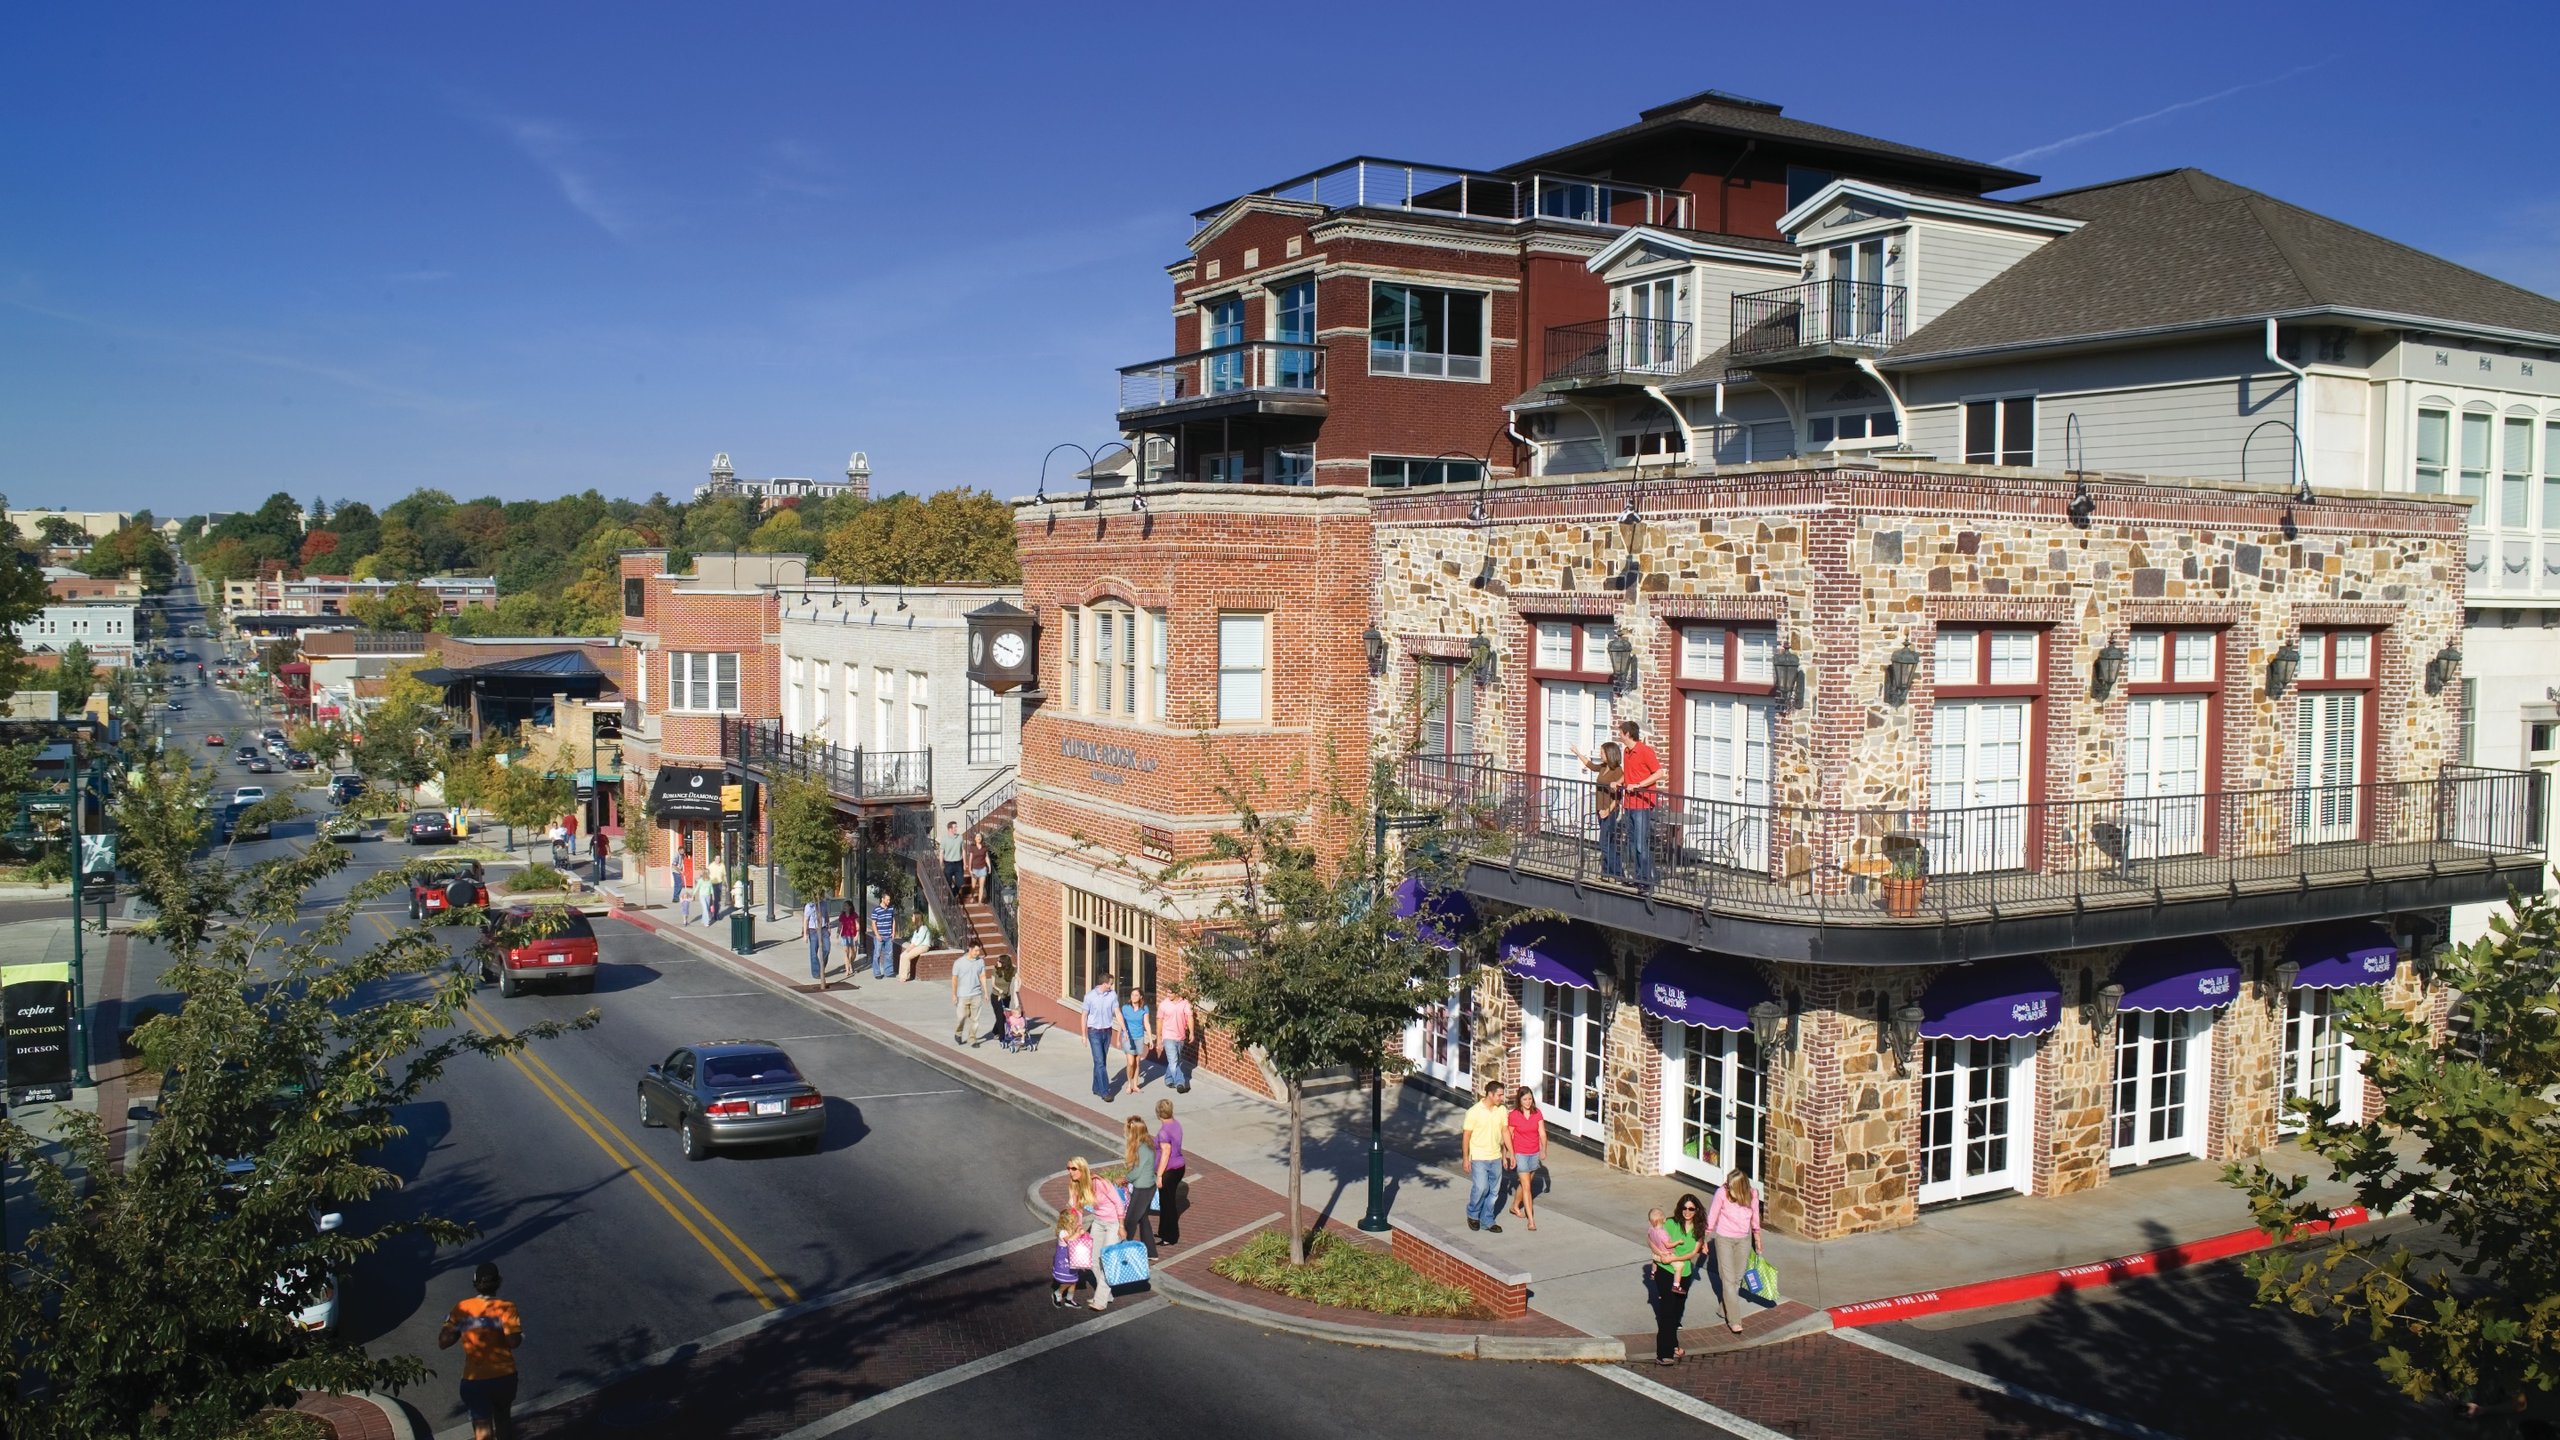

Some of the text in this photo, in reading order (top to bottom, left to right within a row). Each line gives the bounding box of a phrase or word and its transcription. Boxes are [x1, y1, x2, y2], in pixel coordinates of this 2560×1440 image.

[1061, 736, 1100, 762] KUTAK
[1102, 744, 1138, 770] ROCK
[17, 1004, 55, 1018] explore
[9, 1025, 65, 1036] DOWNTOWN
[16, 1044, 60, 1055] DICKSON
[2339, 1207, 2357, 1217] LANE
[2058, 1269, 2071, 1278] NO
[2069, 1263, 2104, 1276] PARKING
[2123, 1255, 2145, 1265] LANE
[1839, 1292, 1940, 1314] NO PARKING FIRE LANE
